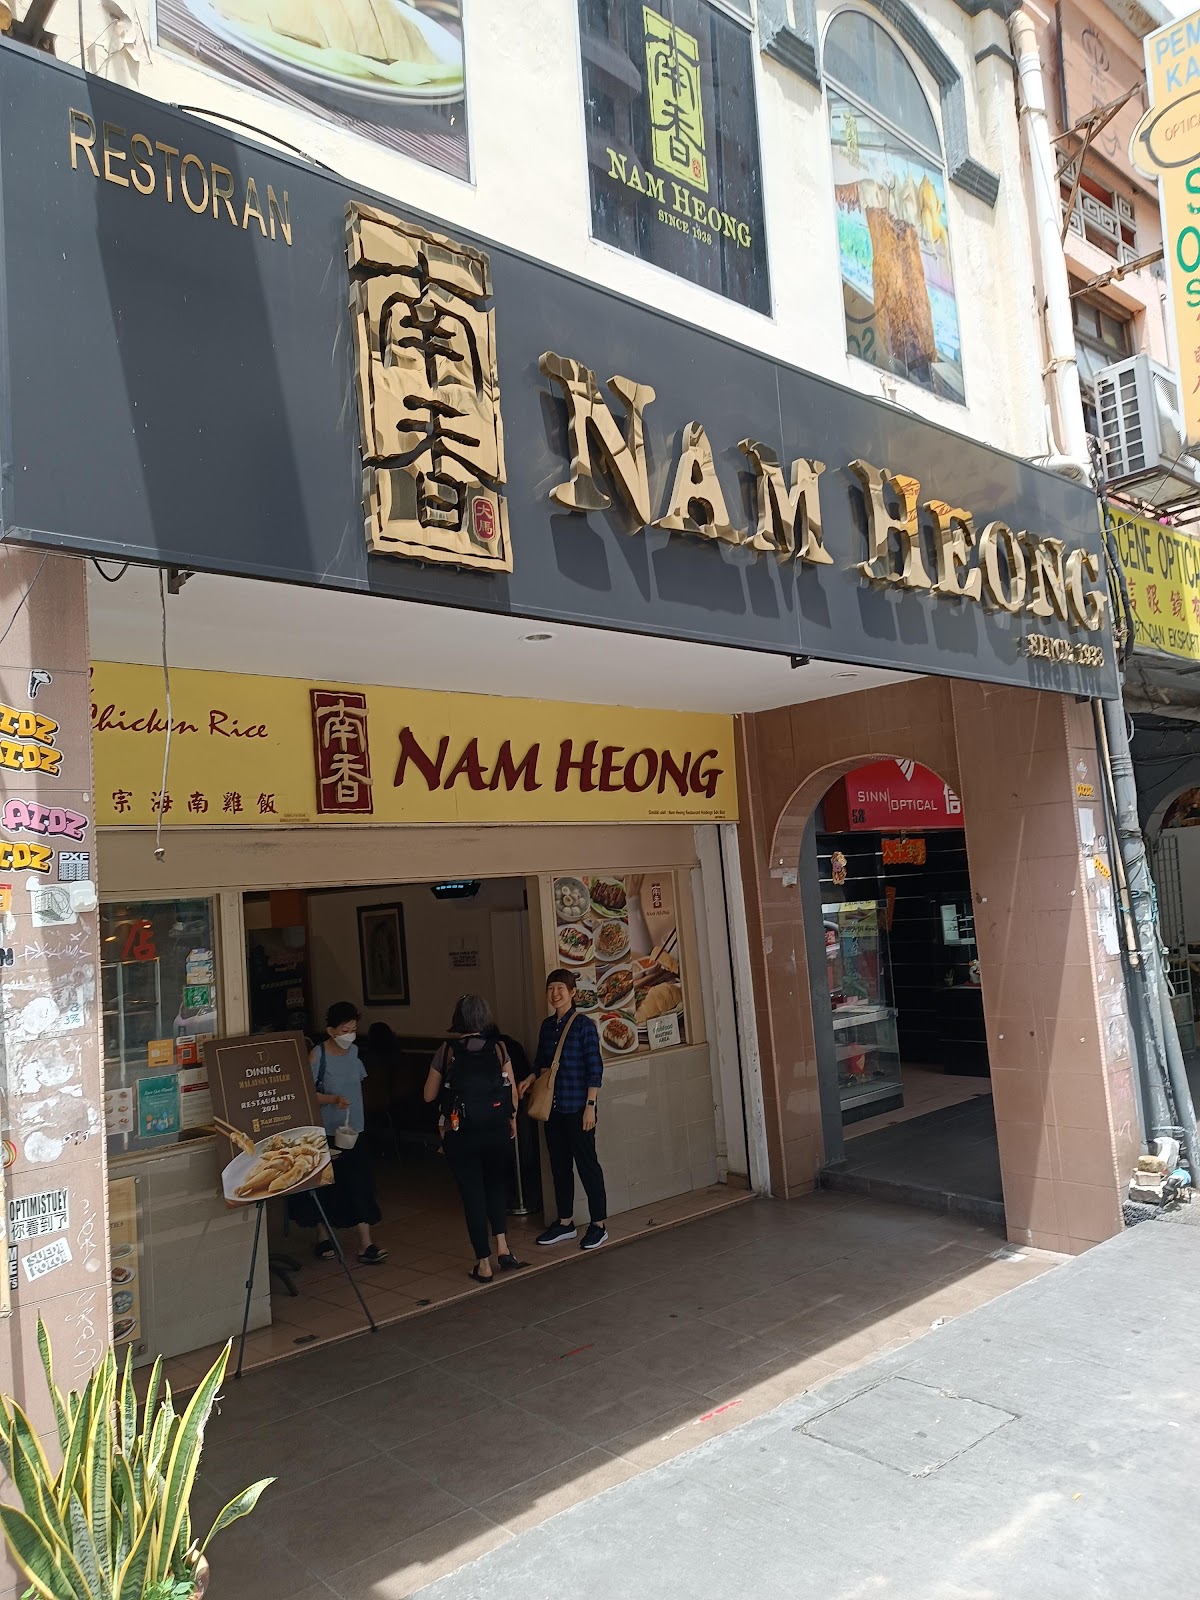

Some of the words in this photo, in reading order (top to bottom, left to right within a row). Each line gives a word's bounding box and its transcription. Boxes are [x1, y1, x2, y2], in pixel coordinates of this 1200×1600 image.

[644, 25, 706, 170] 南香
[1165, 115, 1200, 141] OPTIC
[69, 107, 292, 246] RESTORAN
[606, 147, 666, 203] NAM
[671, 182, 752, 248] HEONG
[658, 209, 690, 235] SINCE
[692, 225, 713, 246] 1938
[347, 235, 506, 535] 南香
[538, 350, 834, 566] NAM
[847, 458, 1106, 631] HEONG
[209, 709, 269, 738] Rice
[313, 699, 374, 804] 南香
[393, 726, 543, 792] NAM
[554, 738, 725, 799] HEONG
[857, 791, 888, 803] SINN
[890, 799, 939, 812] OPTICAL
[246, 1064, 281, 1077] DINING
[240, 1094, 296, 1109] RESTAURANTS
[258, 1088, 277, 1098] BEST
[261, 1104, 279, 1113] 2021
[10, 1213, 68, 1240] 你看到了
